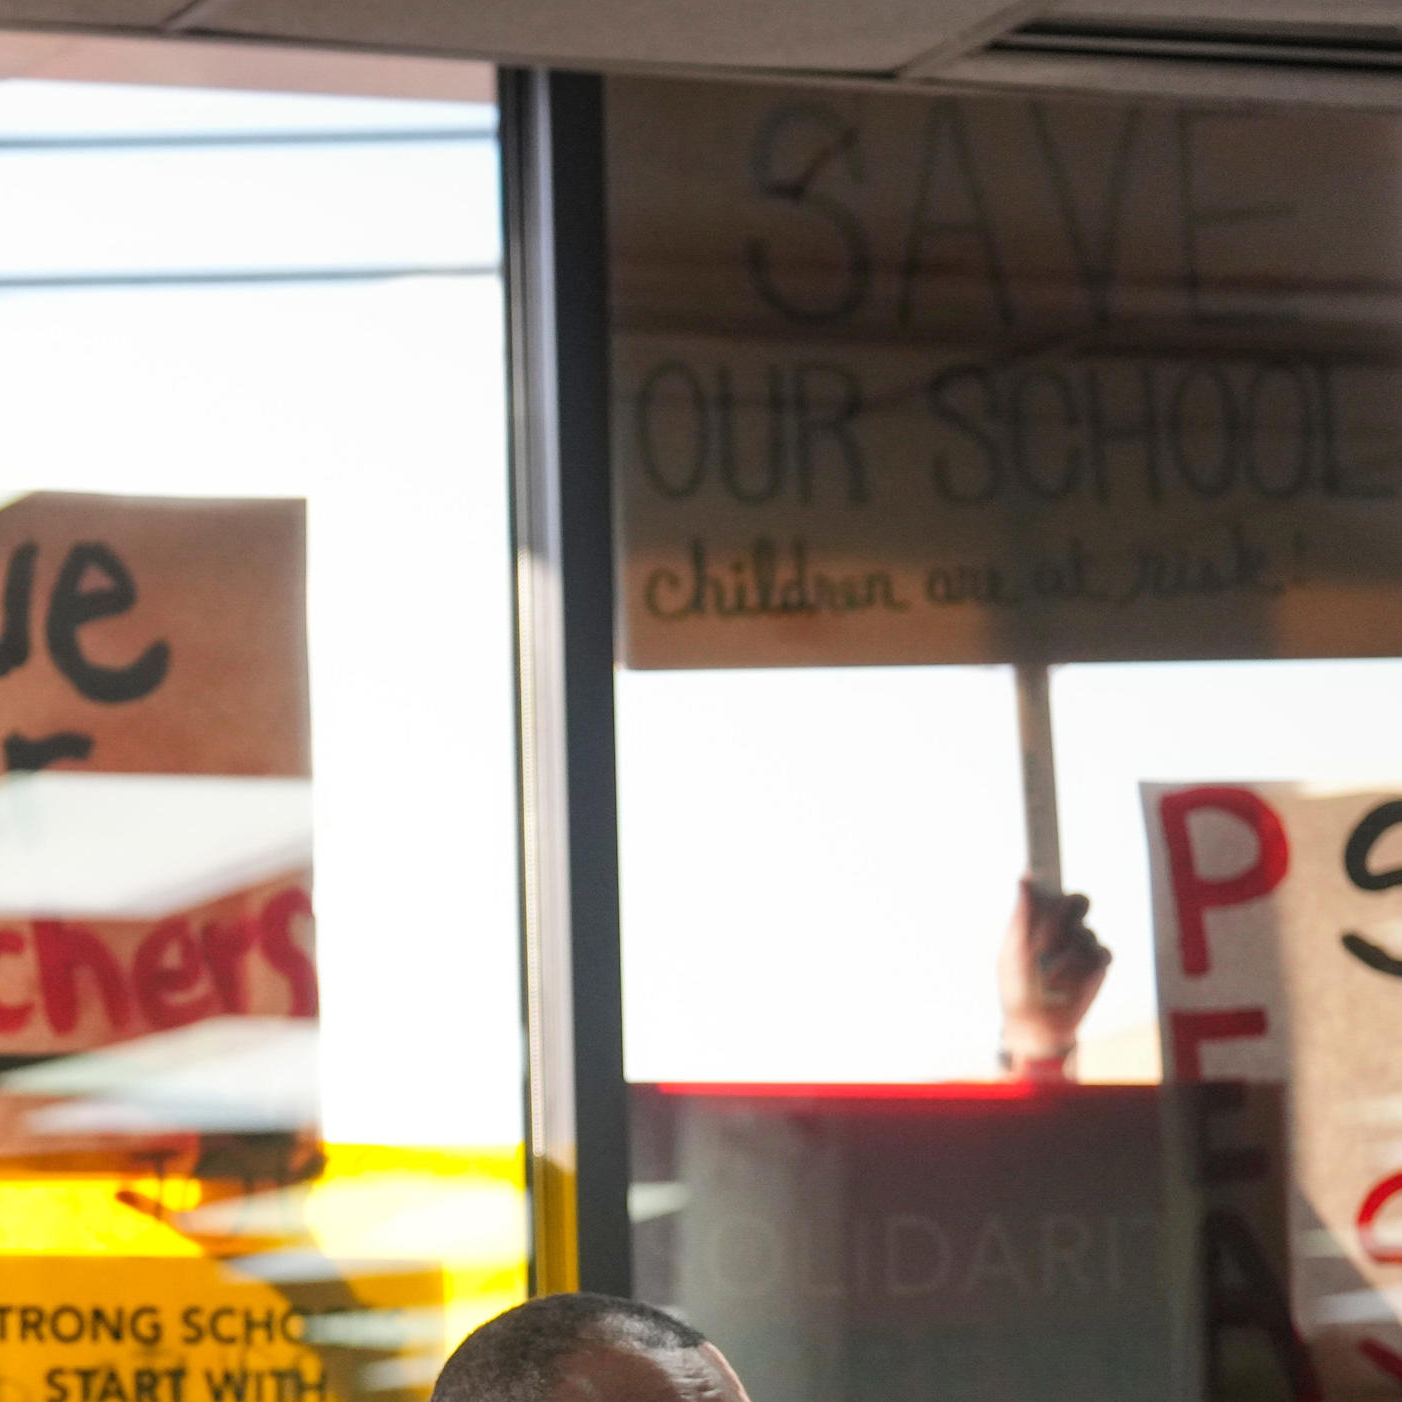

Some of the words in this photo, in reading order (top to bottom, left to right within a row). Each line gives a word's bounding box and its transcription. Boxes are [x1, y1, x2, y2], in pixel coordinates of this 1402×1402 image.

[744, 96, 1300, 330] SAVE
[637, 359, 873, 506] OUR
[181, 1302, 314, 1347] SCHO
